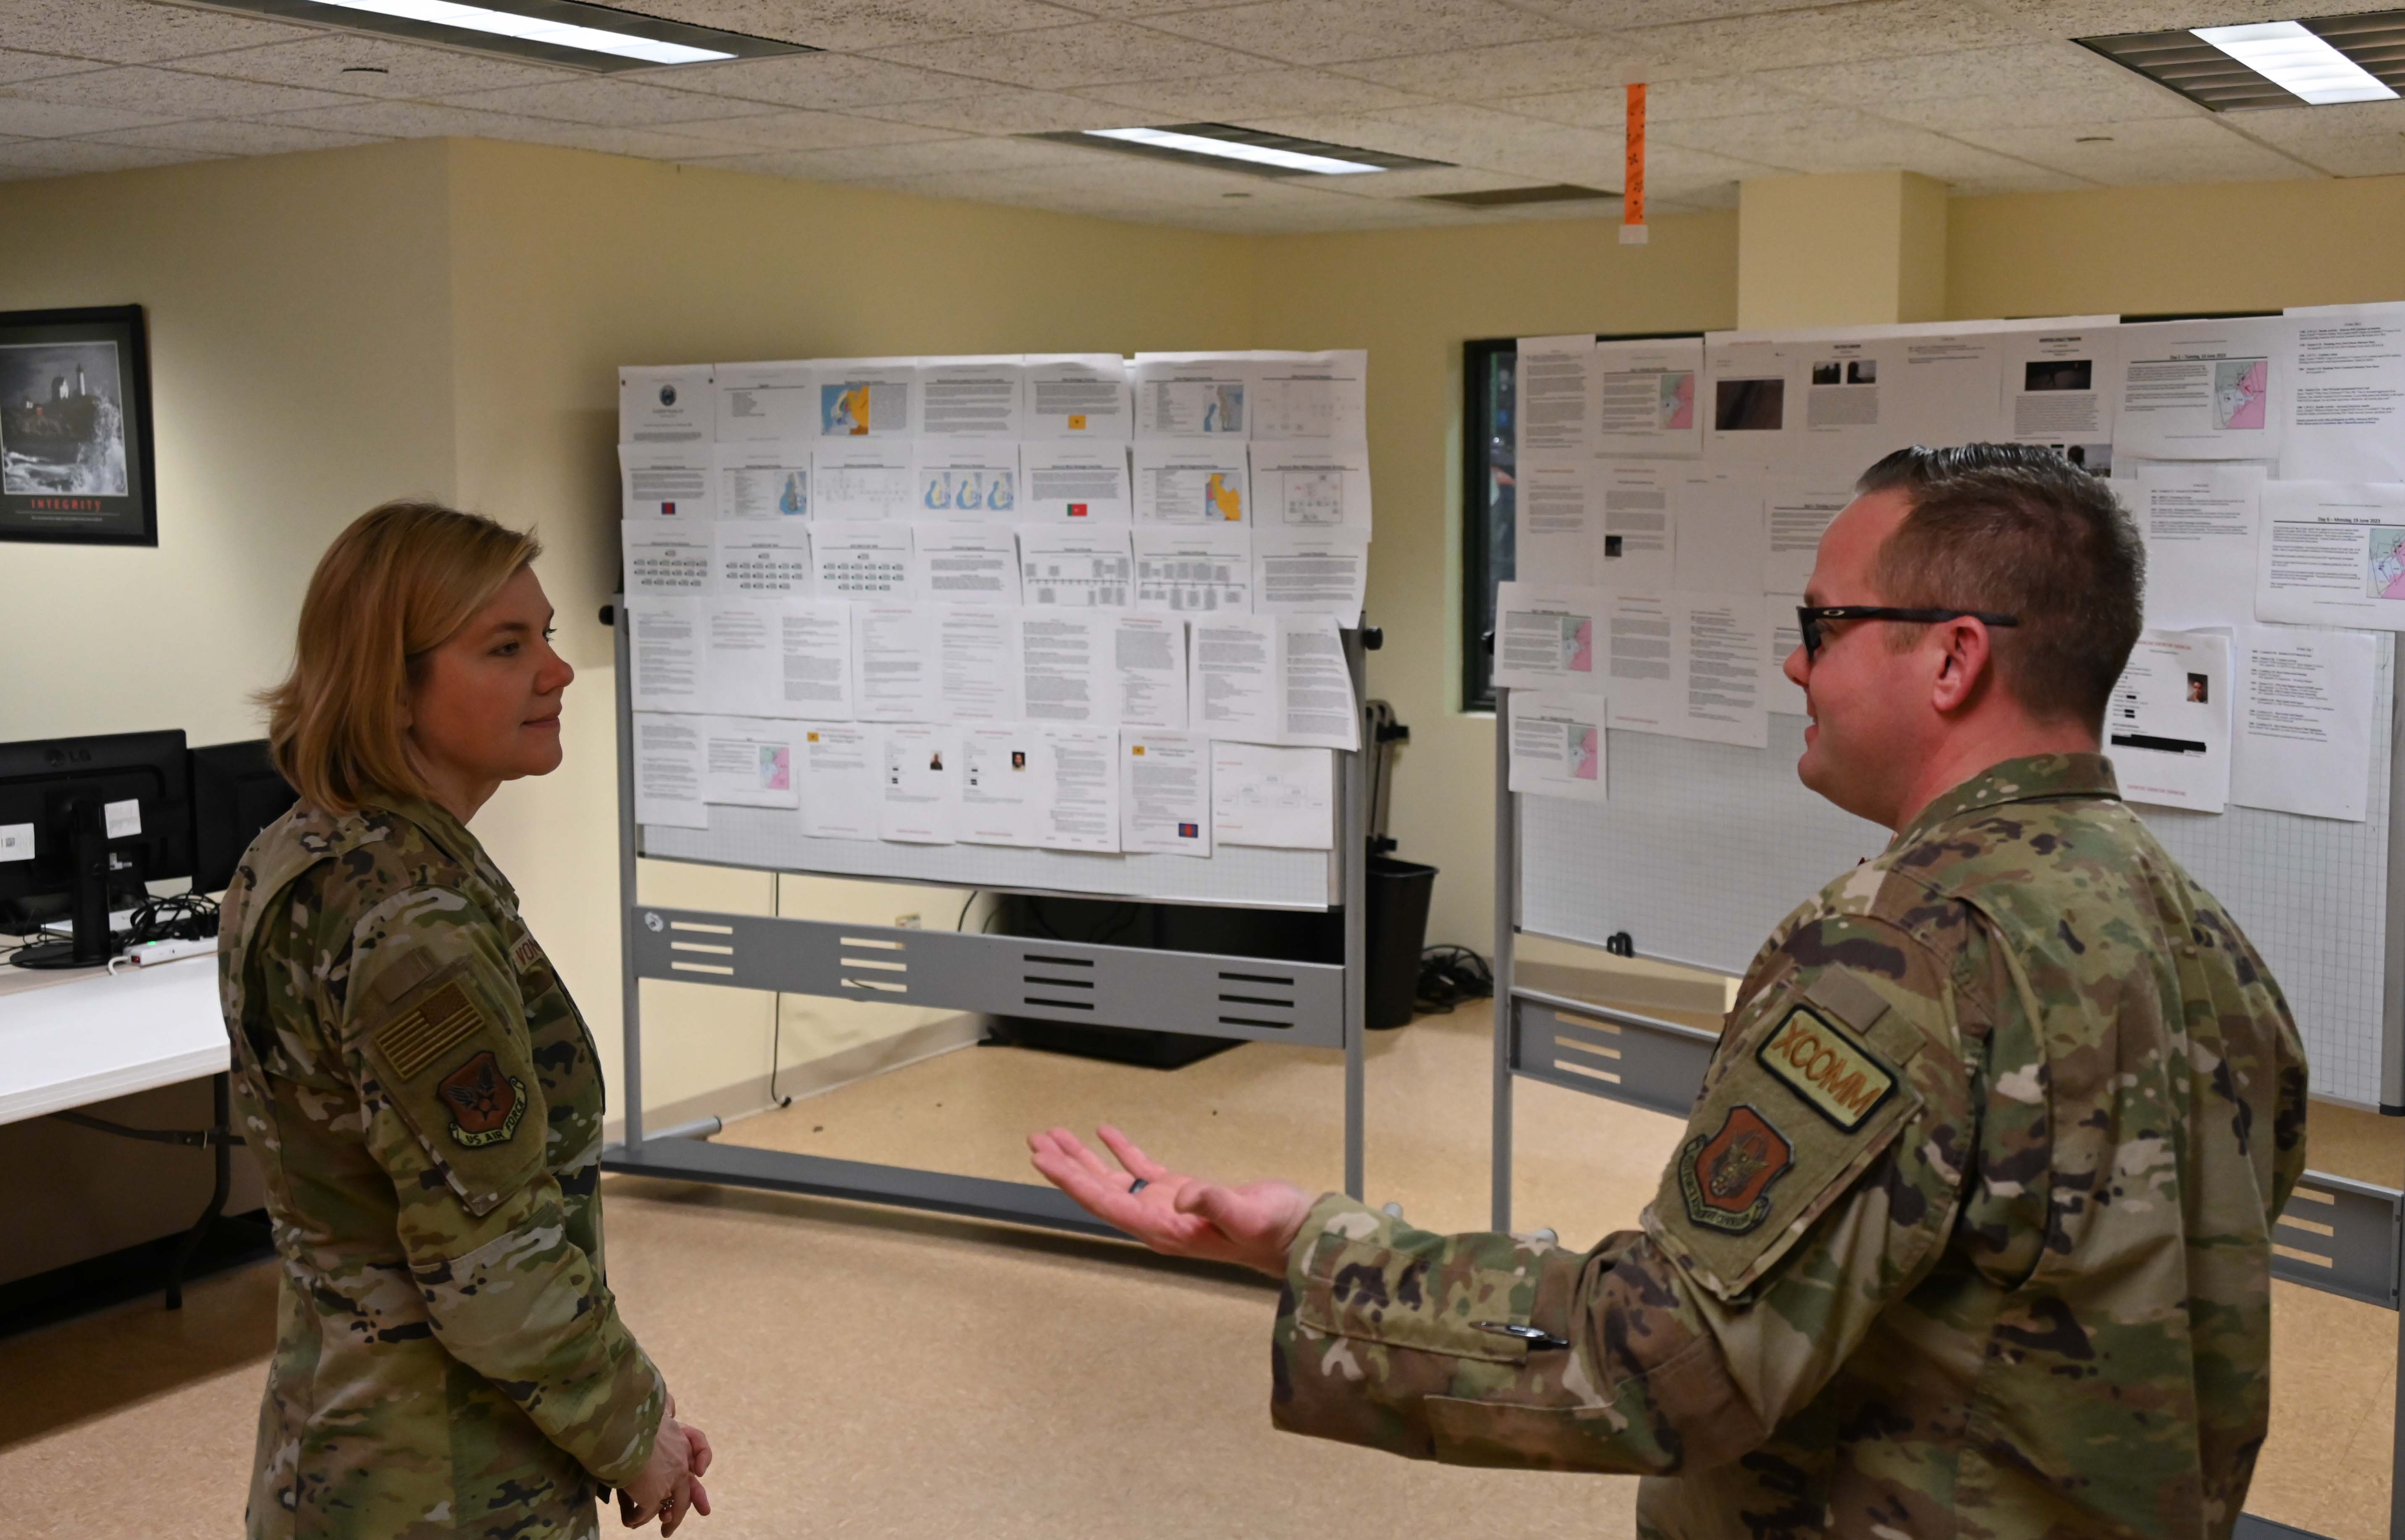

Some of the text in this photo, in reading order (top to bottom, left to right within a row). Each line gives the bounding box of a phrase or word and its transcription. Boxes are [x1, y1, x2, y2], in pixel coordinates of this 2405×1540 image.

[31, 498, 101, 512] INTEGRITY
[1772, 1019, 1882, 1115] XCOMM
[465, 1097, 525, 1144] US AIR FORCE
